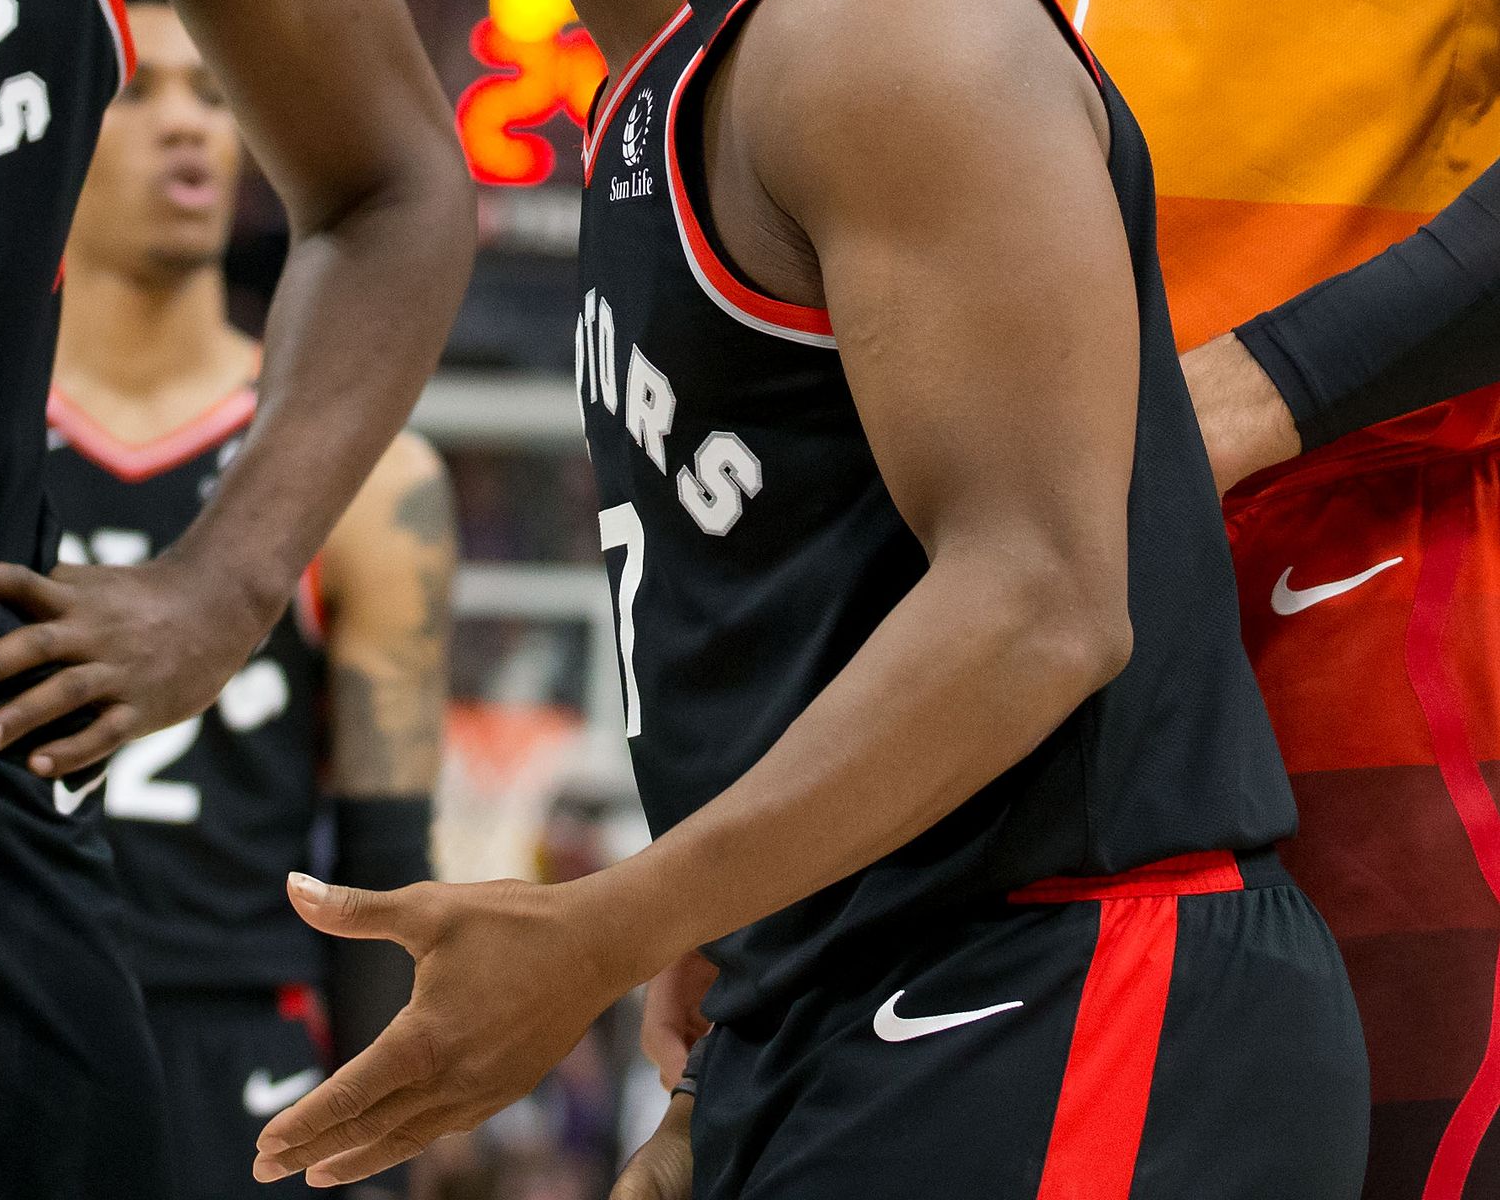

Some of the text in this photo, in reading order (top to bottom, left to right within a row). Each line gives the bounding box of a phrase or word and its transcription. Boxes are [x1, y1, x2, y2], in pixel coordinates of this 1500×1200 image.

[609, 167, 653, 202] Sun Life
[598, 501, 645, 739] 7
